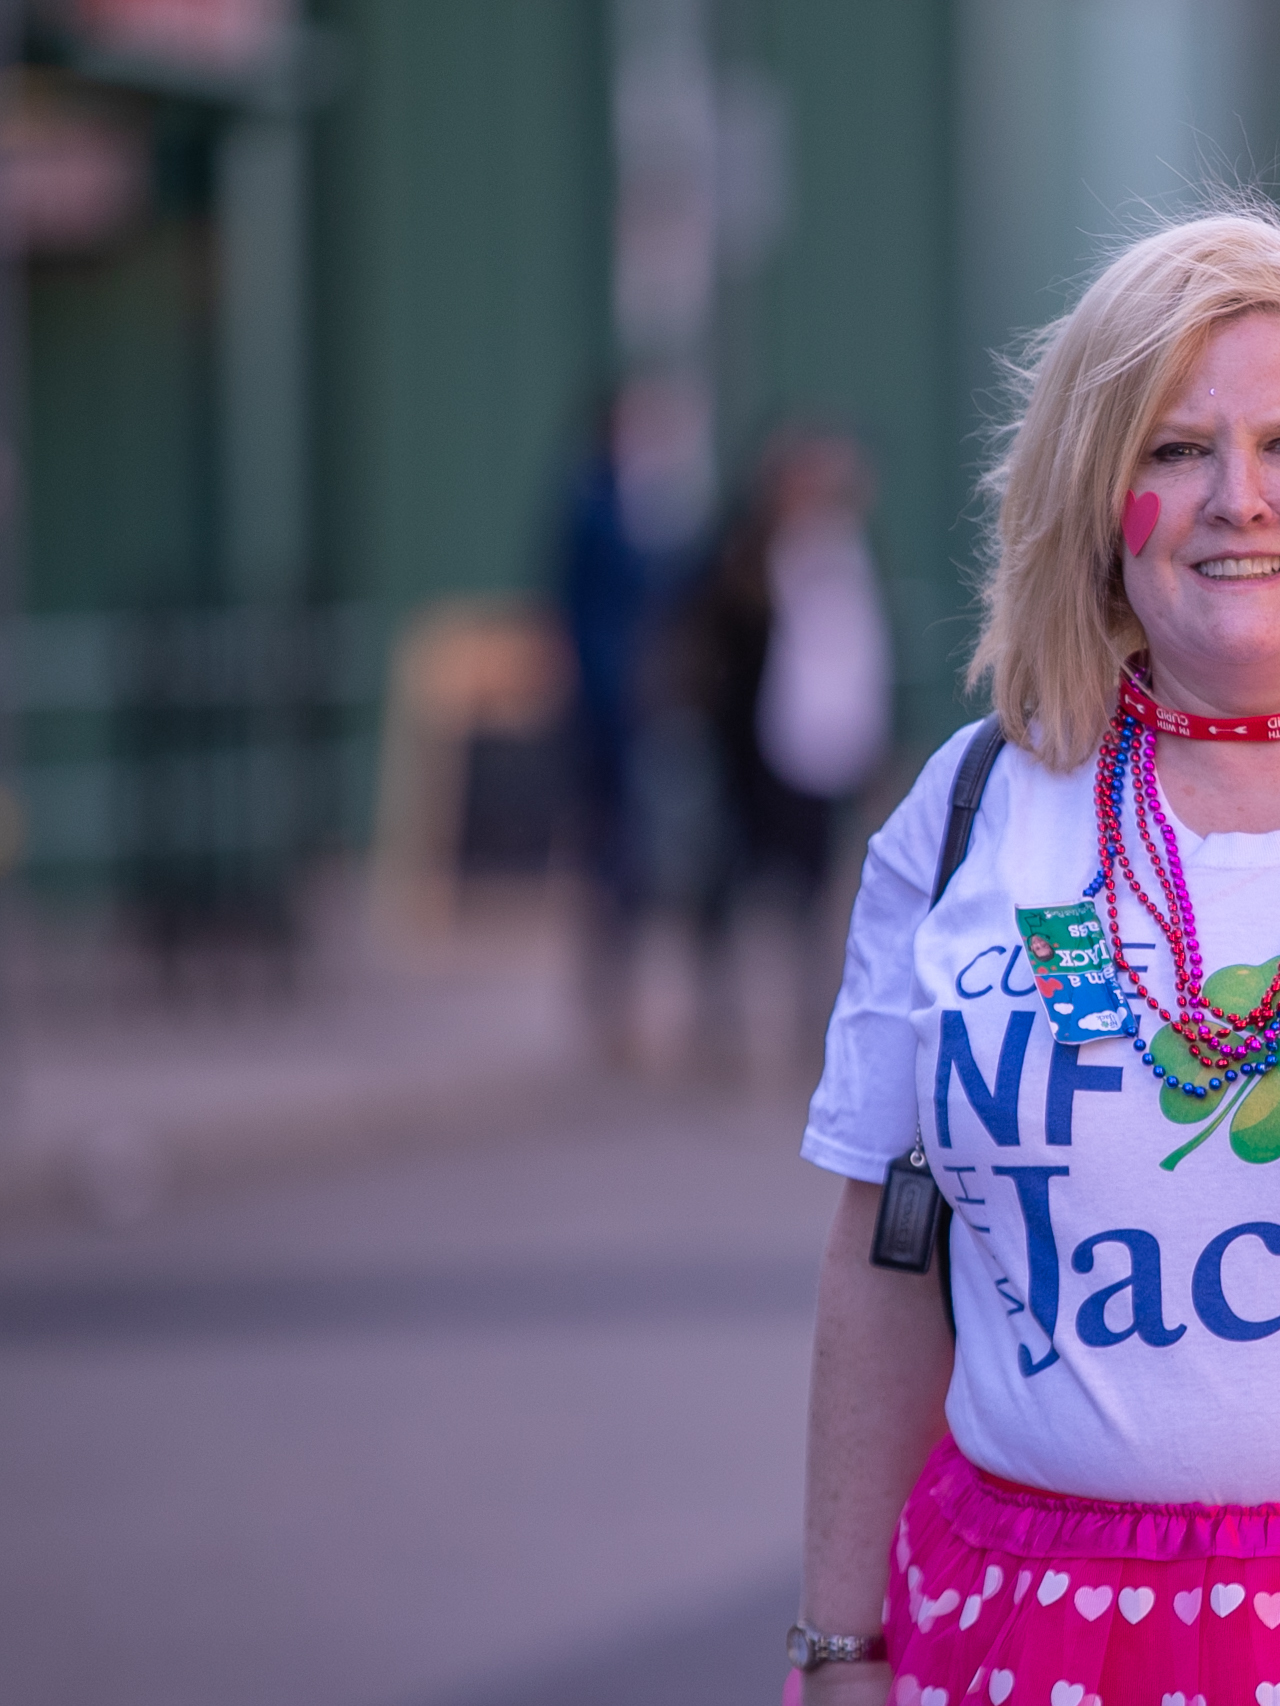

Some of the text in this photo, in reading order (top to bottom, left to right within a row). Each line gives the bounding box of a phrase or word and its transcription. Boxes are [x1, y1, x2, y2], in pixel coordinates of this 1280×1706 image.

[1155, 708, 1189, 726] CUPID
[1156, 720, 1178, 734] WITH
[1068, 921, 1100, 938] ass
[1055, 940, 1110, 967] JACK
[957, 943, 1156, 1000] CUE
[1067, 974, 1082, 988] a
[934, 1009, 1141, 1149] NF
